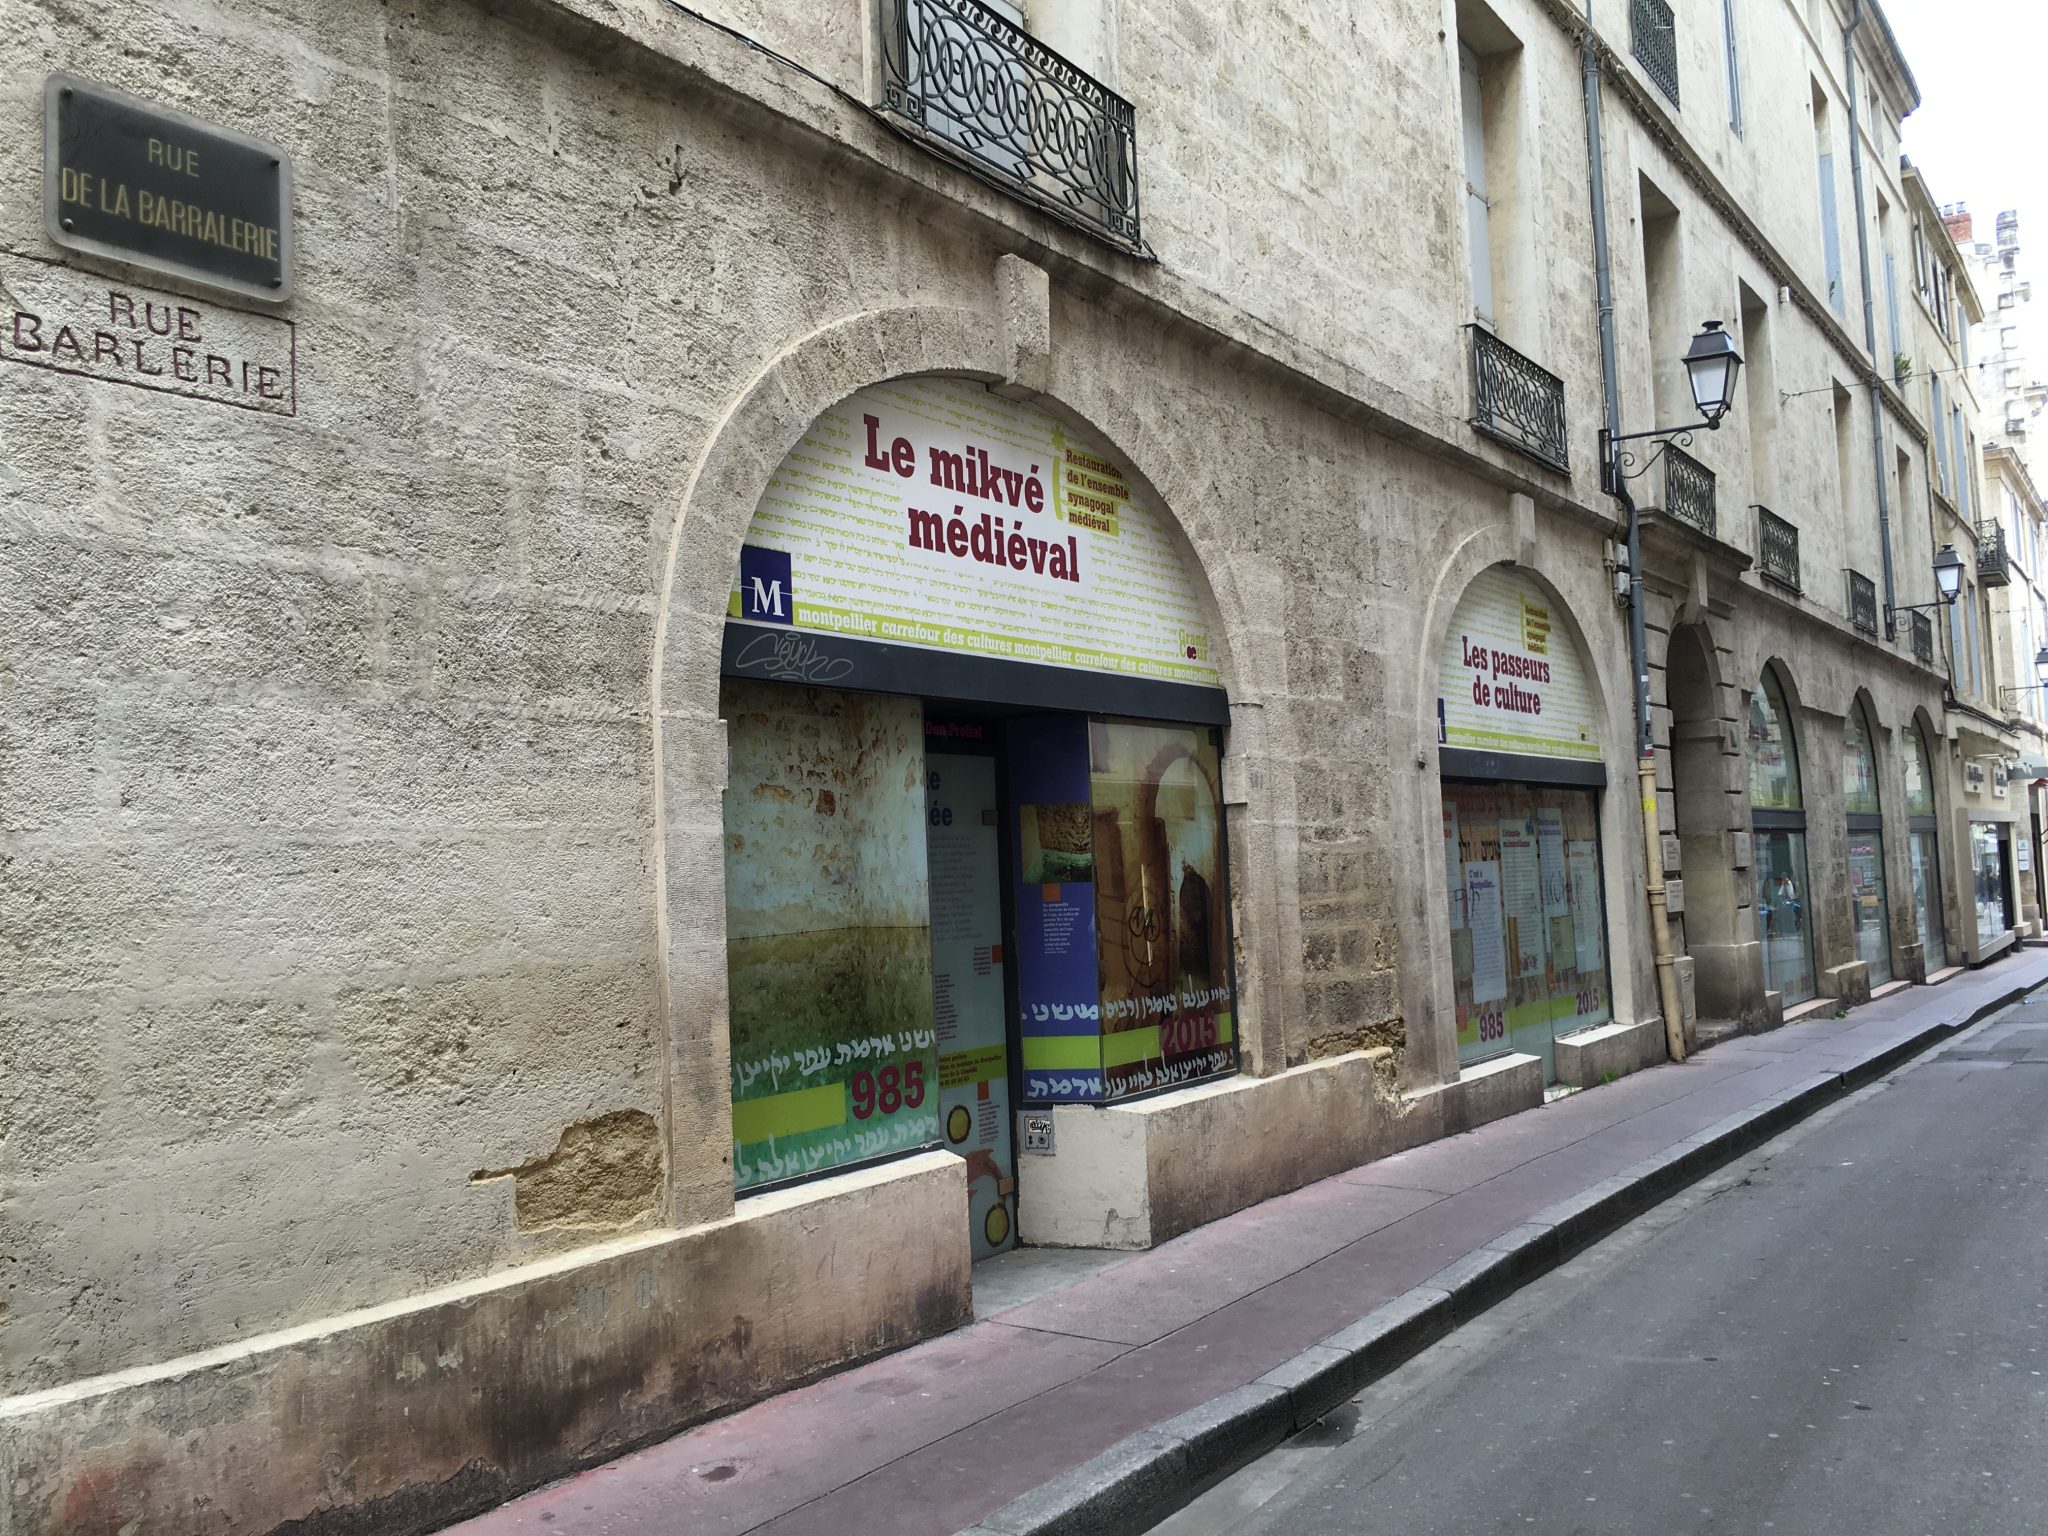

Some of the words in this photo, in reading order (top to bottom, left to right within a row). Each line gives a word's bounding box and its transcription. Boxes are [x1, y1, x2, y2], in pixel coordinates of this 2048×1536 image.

[148, 137, 200, 178] RUE
[62, 167, 93, 208] DE
[101, 178, 130, 220] LA
[139, 190, 278, 262] BARRALERIE
[109, 291, 202, 343] RUE
[12, 311, 284, 400] BARLERIE
[863, 413, 916, 479] Le
[929, 445, 1044, 514] mikvé
[1066, 449, 1122, 480] Restauration
[1067, 469, 1078, 484] de
[1067, 492, 1115, 516] synagogal
[1068, 511, 1110, 532] médiéval
[908, 505, 1080, 583] médiéval
[751, 576, 784, 617] M
[798, 607, 878, 633] montpellier
[881, 618, 940, 643] carrefour
[943, 629, 965, 647] des
[967, 633, 1012, 654] cultures
[1015, 642, 1073, 662] montpellier
[1075, 652, 1119, 670] carrefour
[1120, 656, 1136, 673] des
[1138, 660, 1172, 677] cultures
[1462, 635, 1488, 671] Les
[1491, 649, 1550, 684] passeurs
[1473, 675, 1490, 707] de
[1495, 682, 1541, 716] culture
[1576, 989, 1600, 1016] 2015
[1161, 1011, 1217, 1055] 2015
[1479, 1011, 1504, 1042] 985
[852, 1061, 925, 1120] 985
